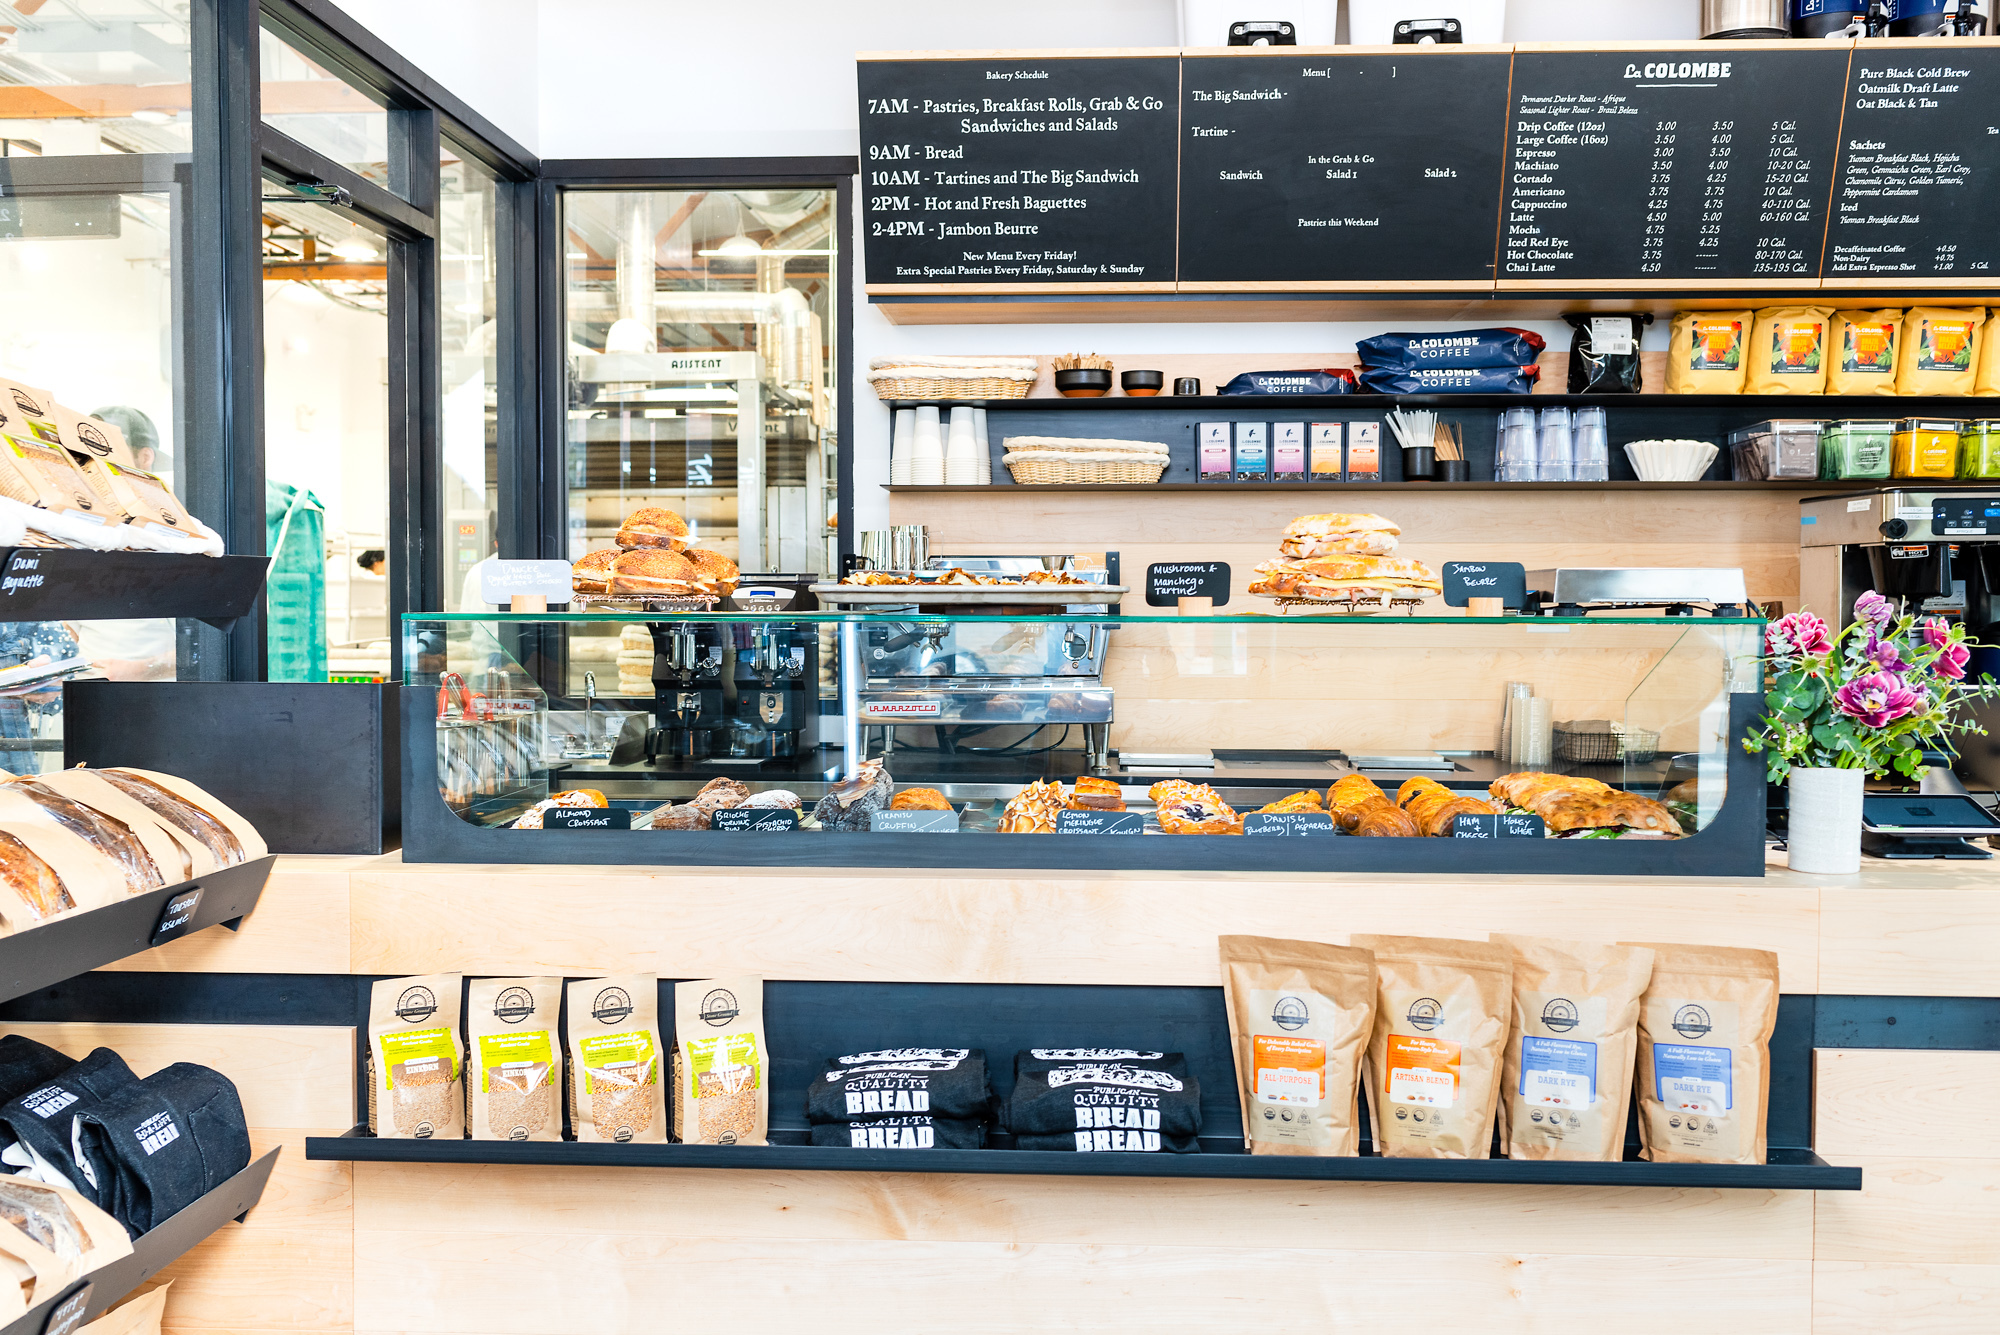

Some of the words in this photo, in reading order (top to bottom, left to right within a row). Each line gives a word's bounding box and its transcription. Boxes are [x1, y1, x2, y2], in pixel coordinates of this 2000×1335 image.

[1303, 68, 1325, 76] Menu
[1624, 64, 1641, 78] La
[1645, 63, 1731, 78] COLOMBE
[1860, 69, 1884, 78] Pure
[1886, 68, 1914, 78] Black
[1917, 68, 1942, 78] Cold
[1943, 68, 1970, 77] Brew
[986, 71, 1013, 81] Bakery
[1015, 71, 1048, 79] Schedule
[1859, 83, 1900, 93] Oatmilk
[1903, 83, 1930, 93] Draft
[1932, 83, 1959, 92] Latte
[1193, 91, 1212, 100] The
[1214, 91, 1231, 103] Big
[1233, 88, 1281, 100] Sandwich
[868, 99, 909, 114] 7AM
[924, 99, 979, 114] Pastries,
[983, 98, 1045, 112] Breakfast
[1048, 98, 1086, 113] Rolls,
[1090, 97, 1122, 110] Grab
[1126, 96, 1139, 110] &
[1143, 96, 1163, 110] Go
[1857, 99, 1875, 108] Oat
[1877, 98, 1905, 108] Black
[1908, 98, 1916, 108] &
[1919, 98, 1938, 108] Tan
[961, 118, 1045, 133] Sandwiches
[1049, 118, 1072, 131] and
[1076, 117, 1118, 131] Salads
[1518, 122, 1541, 134] Drip
[1543, 122, 1574, 131] Coffee
[1577, 122, 1605, 132] (12oz)
[1656, 121, 1676, 130] 3.00
[1712, 121, 1733, 130] 3.50
[1192, 126, 1228, 136] Tartine
[1517, 135, 1544, 147] Large
[1547, 135, 1577, 144] Coffee
[1581, 135, 1608, 146] (16oz)
[1850, 140, 1885, 150] Sachets
[870, 145, 910, 160] 9AM
[925, 145, 963, 159] Bread
[1516, 148, 1556, 160] Espresso
[1333, 155, 1352, 163] Grab
[1354, 155, 1360, 163] &
[1362, 155, 1374, 163] Go
[1515, 161, 1559, 170] Machiato
[1220, 170, 1263, 180] Sandwich
[1326, 169, 1351, 178] Salad
[1425, 168, 1449, 177] Salad
[872, 171, 920, 185] 10AM
[934, 171, 990, 184] Tartines
[994, 171, 1017, 184] and
[1021, 170, 1047, 183] The
[1051, 170, 1073, 187] Big
[1076, 169, 1139, 183] Sandwich
[1514, 174, 1552, 183] Cortado
[1513, 187, 1565, 196] Americano
[872, 196, 910, 210] 2PM
[925, 197, 952, 210] Hot
[955, 196, 979, 210] and
[982, 196, 1020, 209] Fresh
[1023, 196, 1086, 212] Baguettes
[1512, 200, 1567, 211] Cappuccino
[1840, 203, 1858, 211] Iced
[1344, 218, 1378, 226] Weekend
[1510, 213, 1534, 221] Latte
[873, 222, 924, 236] 2-4PM
[938, 222, 991, 239] Jambon
[994, 222, 1038, 235] Beurre
[1509, 225, 1540, 234] Mocha
[1508, 238, 1527, 246] Iced
[1530, 238, 1549, 246] Red
[1551, 238, 1568, 249] Eye
[963, 252, 984, 260] New
[987, 252, 1013, 260] Menu
[1016, 252, 1041, 262] Every
[1044, 251, 1076, 262] Friday!
[1507, 251, 1525, 259] Hot
[1527, 250, 1573, 259] Chocolate
[1833, 255, 1870, 263] Non-Dairy
[897, 267, 921, 275] Extra
[924, 266, 955, 277] Special
[958, 266, 992, 274] Pastries
[994, 266, 1020, 276] Every
[1023, 265, 1054, 276] Friday,
[1057, 265, 1097, 275] Saturday
[1100, 265, 1107, 273] &
[1110, 264, 1144, 275] Sunday
[1506, 263, 1529, 271] Chai
[1532, 263, 1555, 271] Latte
[1408, 340, 1420, 349] La
[1422, 337, 1479, 348] COLOMBE
[1420, 348, 1470, 358] COFFEE
[672, 360, 722, 368] ASISTENT
[1422, 378, 1471, 386] COFFEE
[1154, 564, 1205, 574] Mushroom
[1452, 564, 1486, 574] JAMBON
[2, 574, 44, 595] Baguette
[1154, 577, 1203, 590] Manchego
[1463, 577, 1497, 586] BEURRE
[1155, 586, 1197, 595] Tartine
[556, 810, 591, 818] ALMOND
[716, 811, 749, 820] BRIOCHE
[1263, 815, 1305, 823] DANISH
[568, 818, 610, 827] CROISSANT
[719, 820, 750, 828] MORNING
[756, 820, 792, 831] PISTACHIO
[879, 822, 916, 830] CRUFFIN
[1064, 819, 1103, 827] MERINGUE
[1460, 817, 1480, 826] HAM
[1504, 816, 1531, 829] HONEY
[1510, 826, 1535, 835] WHEAT
[1264, 1074, 1312, 1084] ALL-PURPOSE
[1395, 1073, 1424, 1083] ARTISAN
[1427, 1076, 1449, 1085] BLEND
[1538, 1076, 1558, 1086] DARK
[1561, 1078, 1576, 1086] RYE
[1093, 1086, 1141, 1095] PUBLICAN
[1674, 1082, 1694, 1093] DARK
[1697, 1085, 1711, 1093] RYE
[845, 1091, 929, 1114] BREAD
[1075, 1107, 1161, 1129] BREAD
[850, 1127, 934, 1148] BREAD
[1074, 1130, 1161, 1152] BREAD
